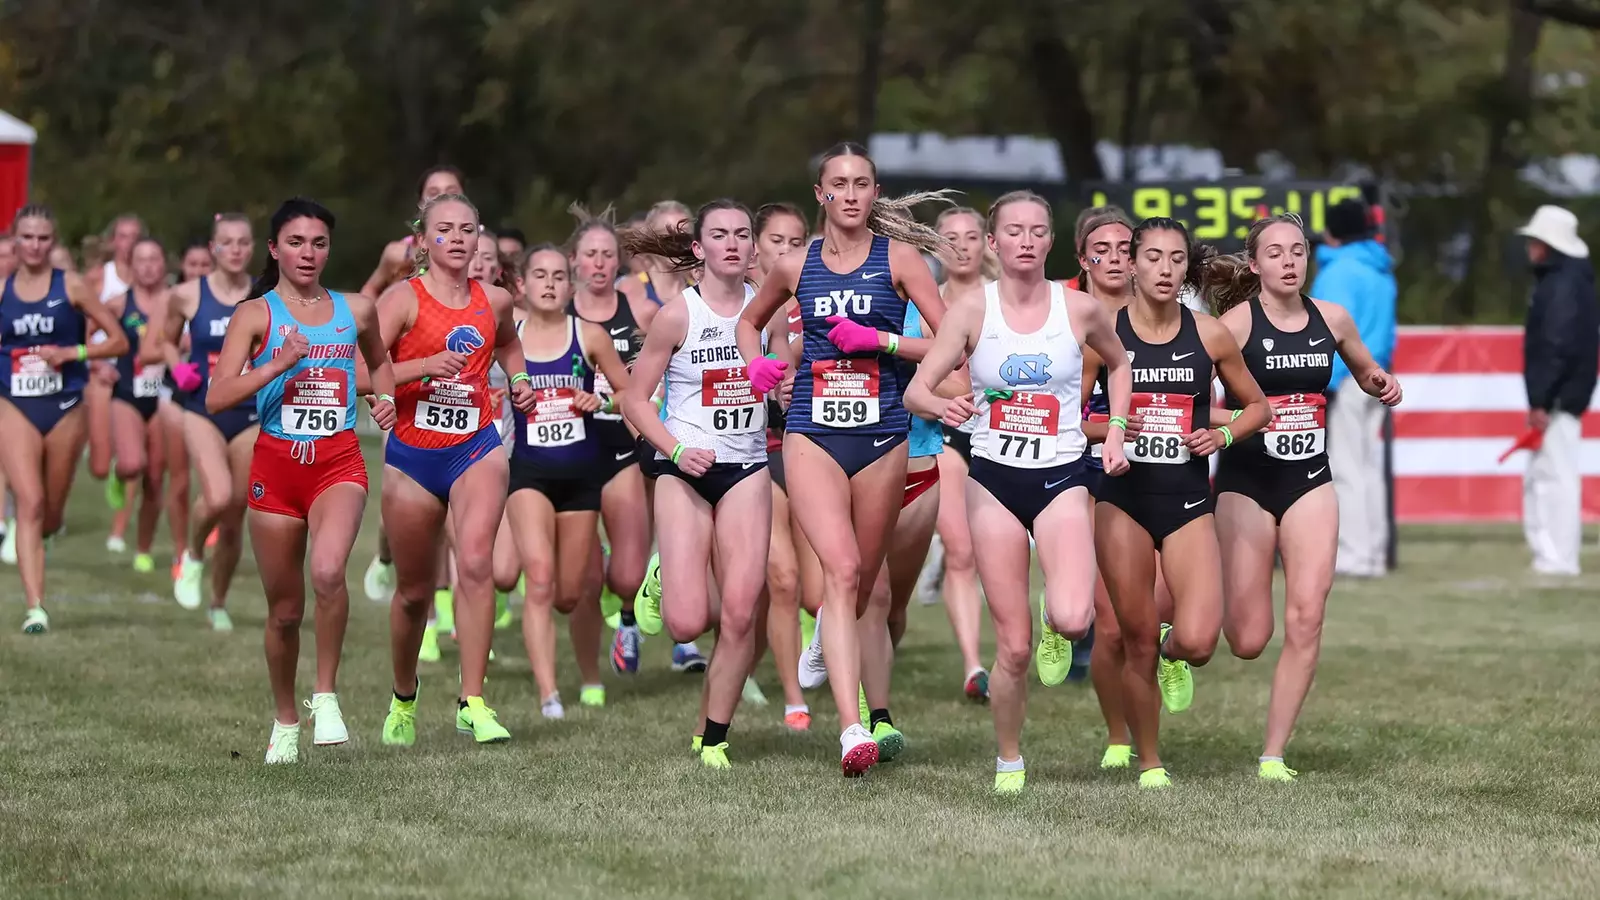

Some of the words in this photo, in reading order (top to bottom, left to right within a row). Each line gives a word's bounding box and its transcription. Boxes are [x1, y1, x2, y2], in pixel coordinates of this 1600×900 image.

[814, 290, 872, 318] BYU
[13, 313, 55, 336] BYU
[703, 326, 719, 334] BIG
[700, 331, 723, 340] EAST
[1265, 353, 1329, 370] STANFORD
[1132, 367, 1194, 382] TANFORD
[295, 381, 341, 389] NUTTYCOMBE
[530, 375, 584, 390] HINGTON
[298, 389, 335, 397] WISCONSIN
[717, 388, 751, 397] WISCONSIN
[822, 388, 871, 396] INVITATIONAL
[293, 396, 341, 405] INVITATIONAL
[712, 395, 756, 405] INVITATIONAL
[426, 405, 468, 430] 538
[822, 400, 867, 423] 559
[1001, 404, 1050, 417] NUTTYCOMBE
[293, 409, 337, 431] 756
[713, 407, 754, 430] 617
[1004, 414, 1043, 425] WISCONSIN
[1275, 420, 1319, 430] INVITATIONAL
[537, 422, 575, 443] 982
[999, 421, 1049, 433] INVITATIONAL
[999, 434, 1041, 460] 771
[1134, 435, 1180, 459] 868
[1276, 432, 1316, 456] 862
